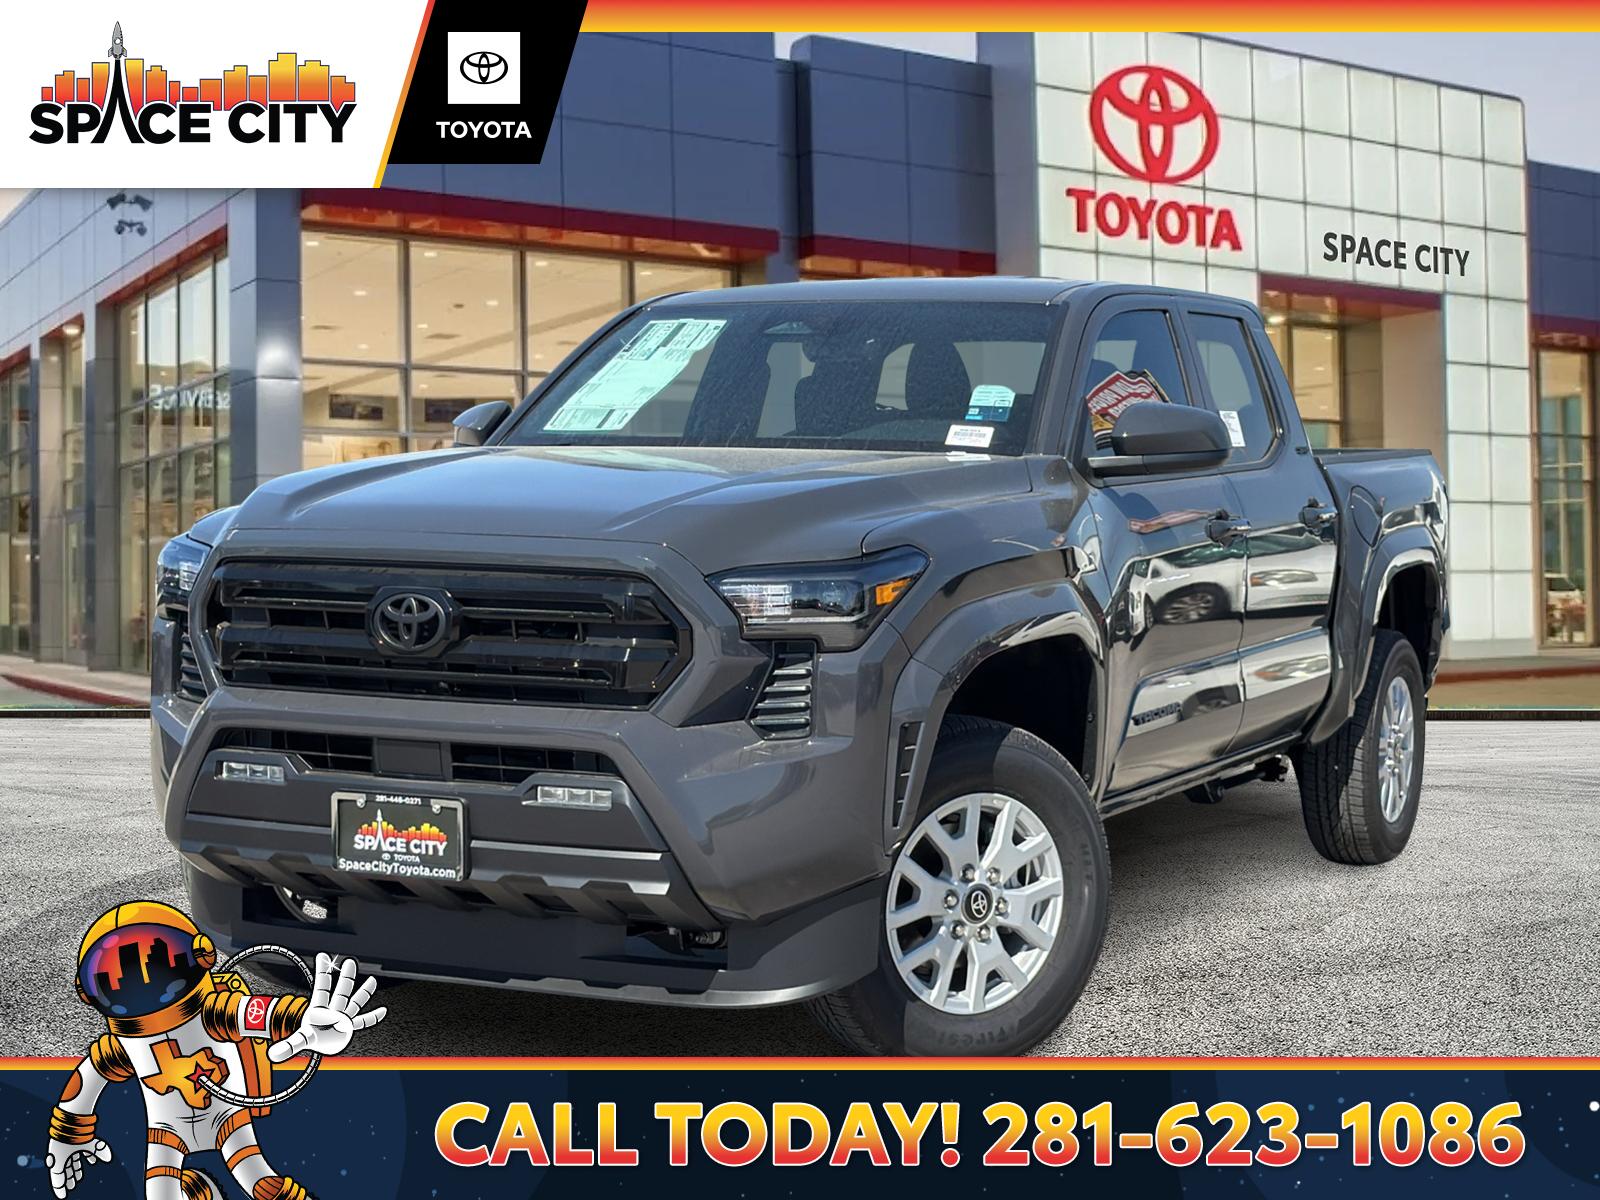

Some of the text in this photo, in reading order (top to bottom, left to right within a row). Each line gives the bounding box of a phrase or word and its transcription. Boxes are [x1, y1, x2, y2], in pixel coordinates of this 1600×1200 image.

[1066, 187, 1242, 251] TOYOTA
[1323, 232, 1471, 277] SPACE CITY
[1132, 702, 1182, 726] TACOMA
[353, 826, 448, 856] SPACE CITY
[339, 857, 456, 879] SpaceCityToyota.com
[394, 854, 421, 863] TOYOTA
